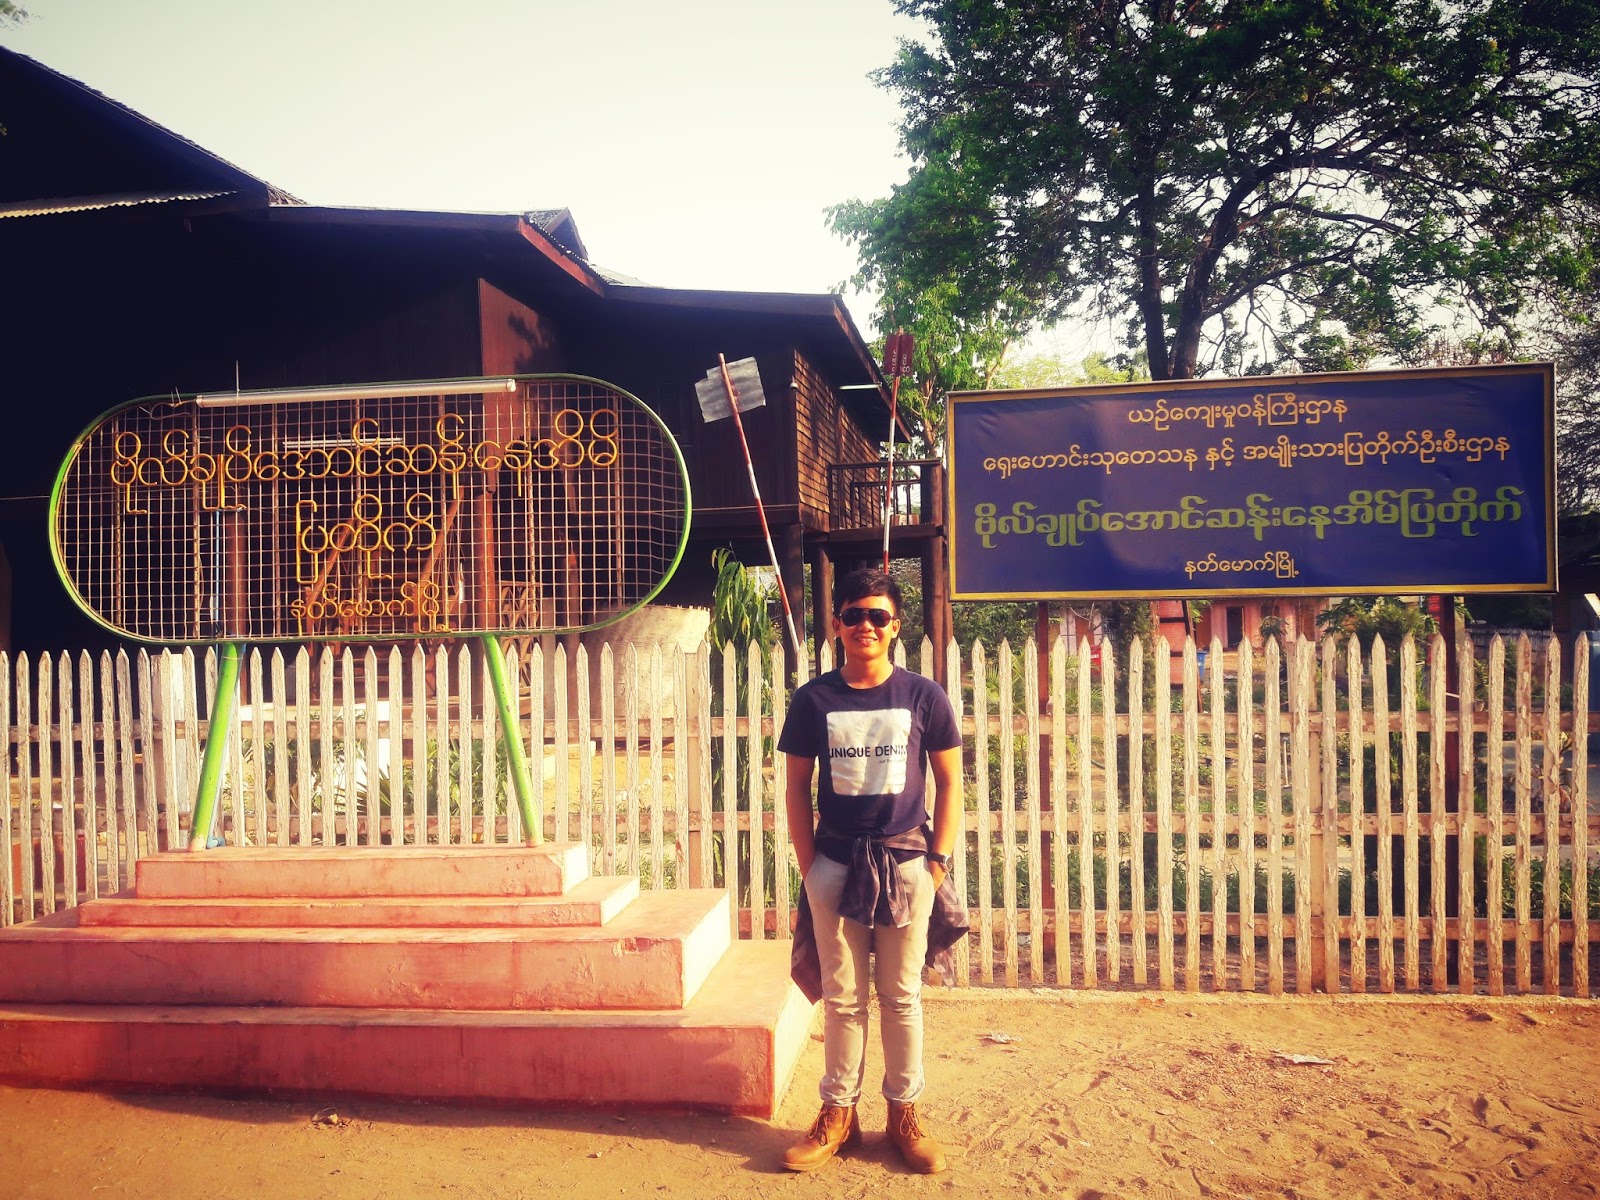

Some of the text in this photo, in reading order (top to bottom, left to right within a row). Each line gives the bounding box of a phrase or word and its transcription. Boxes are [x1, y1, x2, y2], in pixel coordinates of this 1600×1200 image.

[983, 444, 1198, 479] ရှေးဟောင်းသုတေသန
[1184, 551, 1299, 580] နတ်မောက်မြို့
